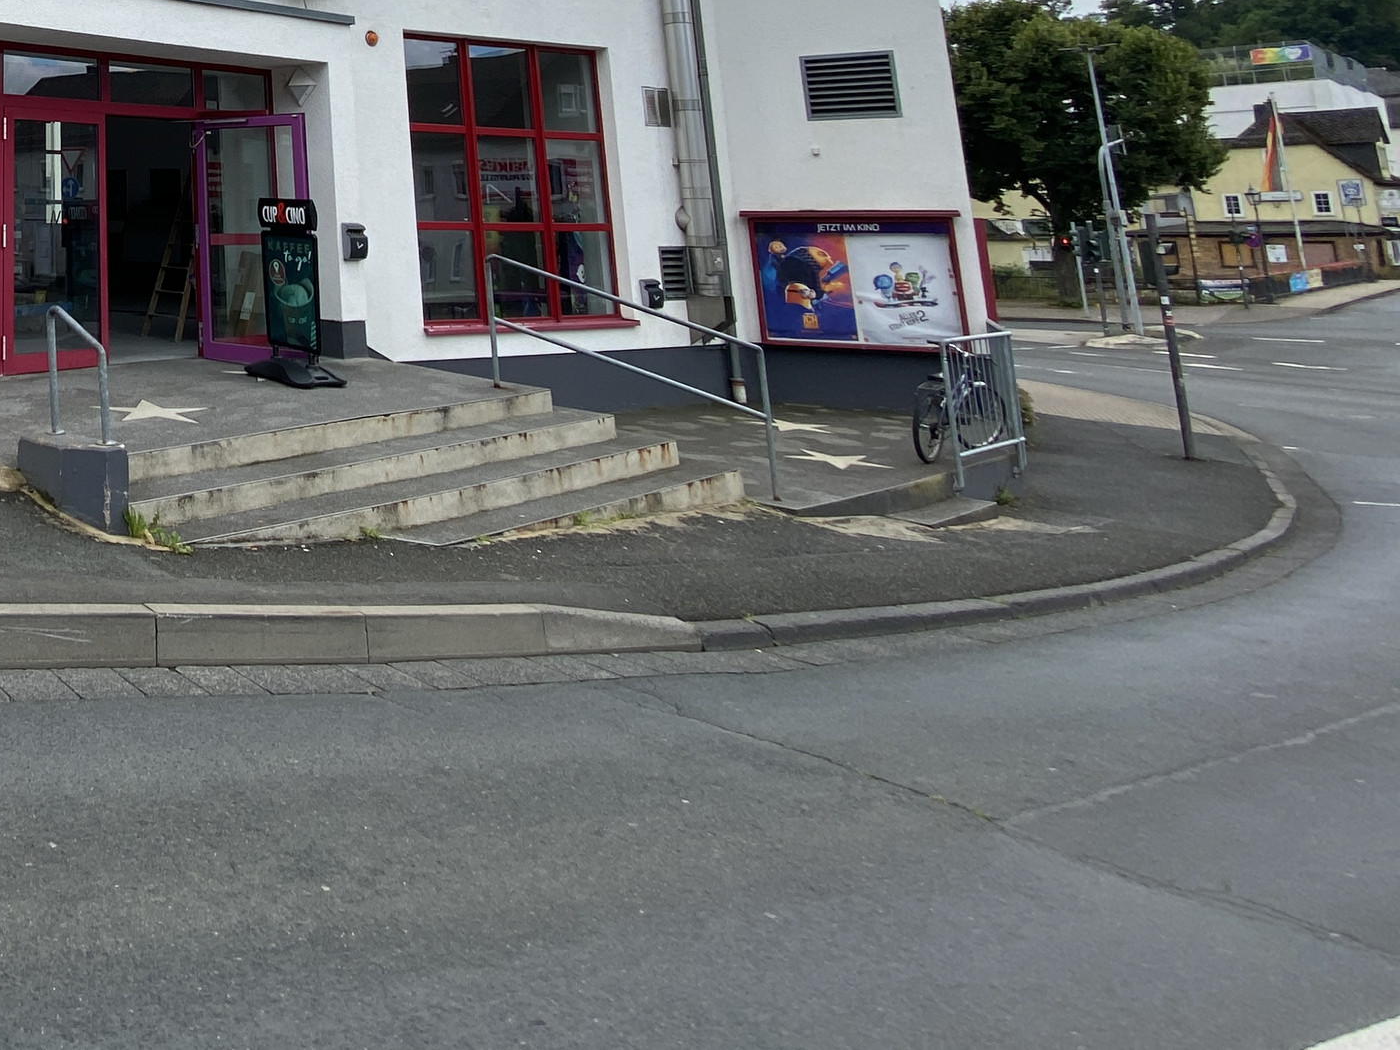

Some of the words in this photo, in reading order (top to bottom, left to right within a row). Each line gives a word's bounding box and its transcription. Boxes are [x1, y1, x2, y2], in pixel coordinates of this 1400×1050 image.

[817, 223, 841, 233] JETZT
[843, 223, 856, 232] IM
[857, 223, 880, 232] KINO
[267, 239, 310, 254] KAFFEE
[283, 250, 293, 263] to
